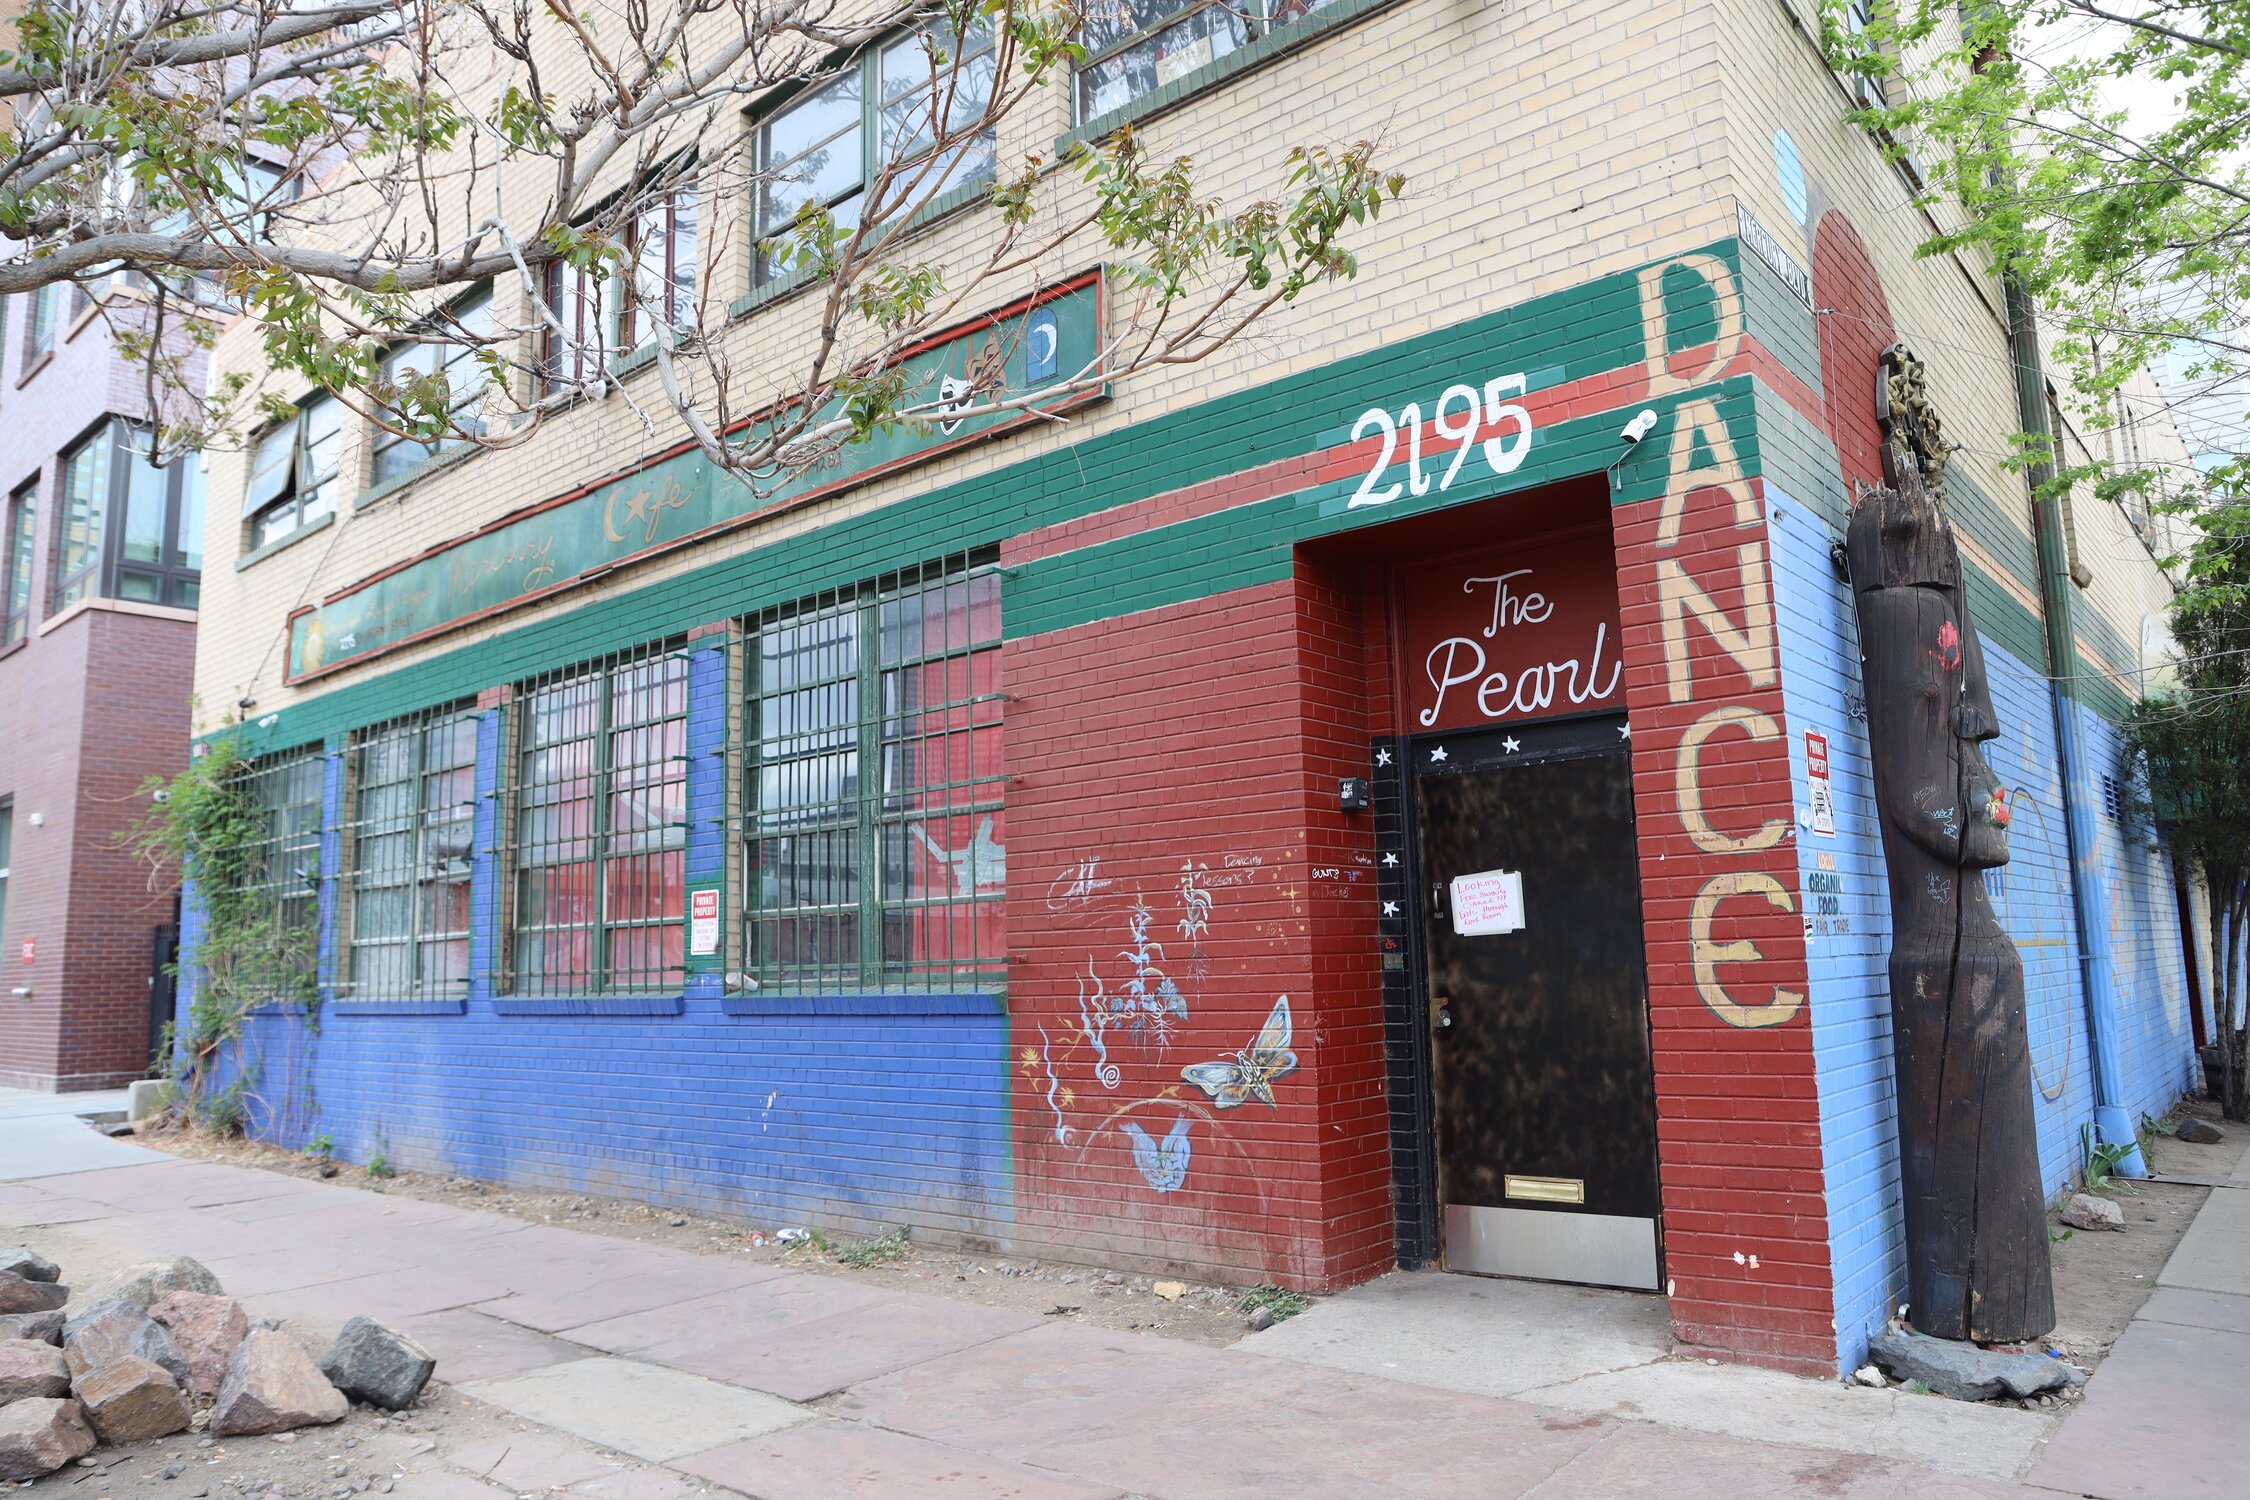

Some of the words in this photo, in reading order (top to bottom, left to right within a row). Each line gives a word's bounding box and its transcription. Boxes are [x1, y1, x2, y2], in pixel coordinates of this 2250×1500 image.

[1744, 209, 1783, 277] MERCURY
[1785, 253, 1810, 306] BLVD
[1347, 372, 1532, 508] 2195
[450, 536, 554, 594] Mercury
[1464, 569, 1554, 638] The
[1637, 253, 1804, 1029] DANCE
[1420, 622, 1622, 726] Pearl
[1809, 739, 1825, 756] PRIVATE
[1808, 756, 1827, 774] PROPERTY
[1912, 784, 1937, 806] MEOW
[1224, 854, 1262, 868] Dancing
[1817, 852, 1836, 872] LOCAL
[1457, 879, 1501, 894] Looking
[696, 895, 714, 906] PRIVATE
[1817, 895, 1839, 915] FOOD
[694, 906, 716, 917] PROPERTY
[1815, 917, 1829, 935] FAIR
[1833, 919, 1850, 935] TRADE
